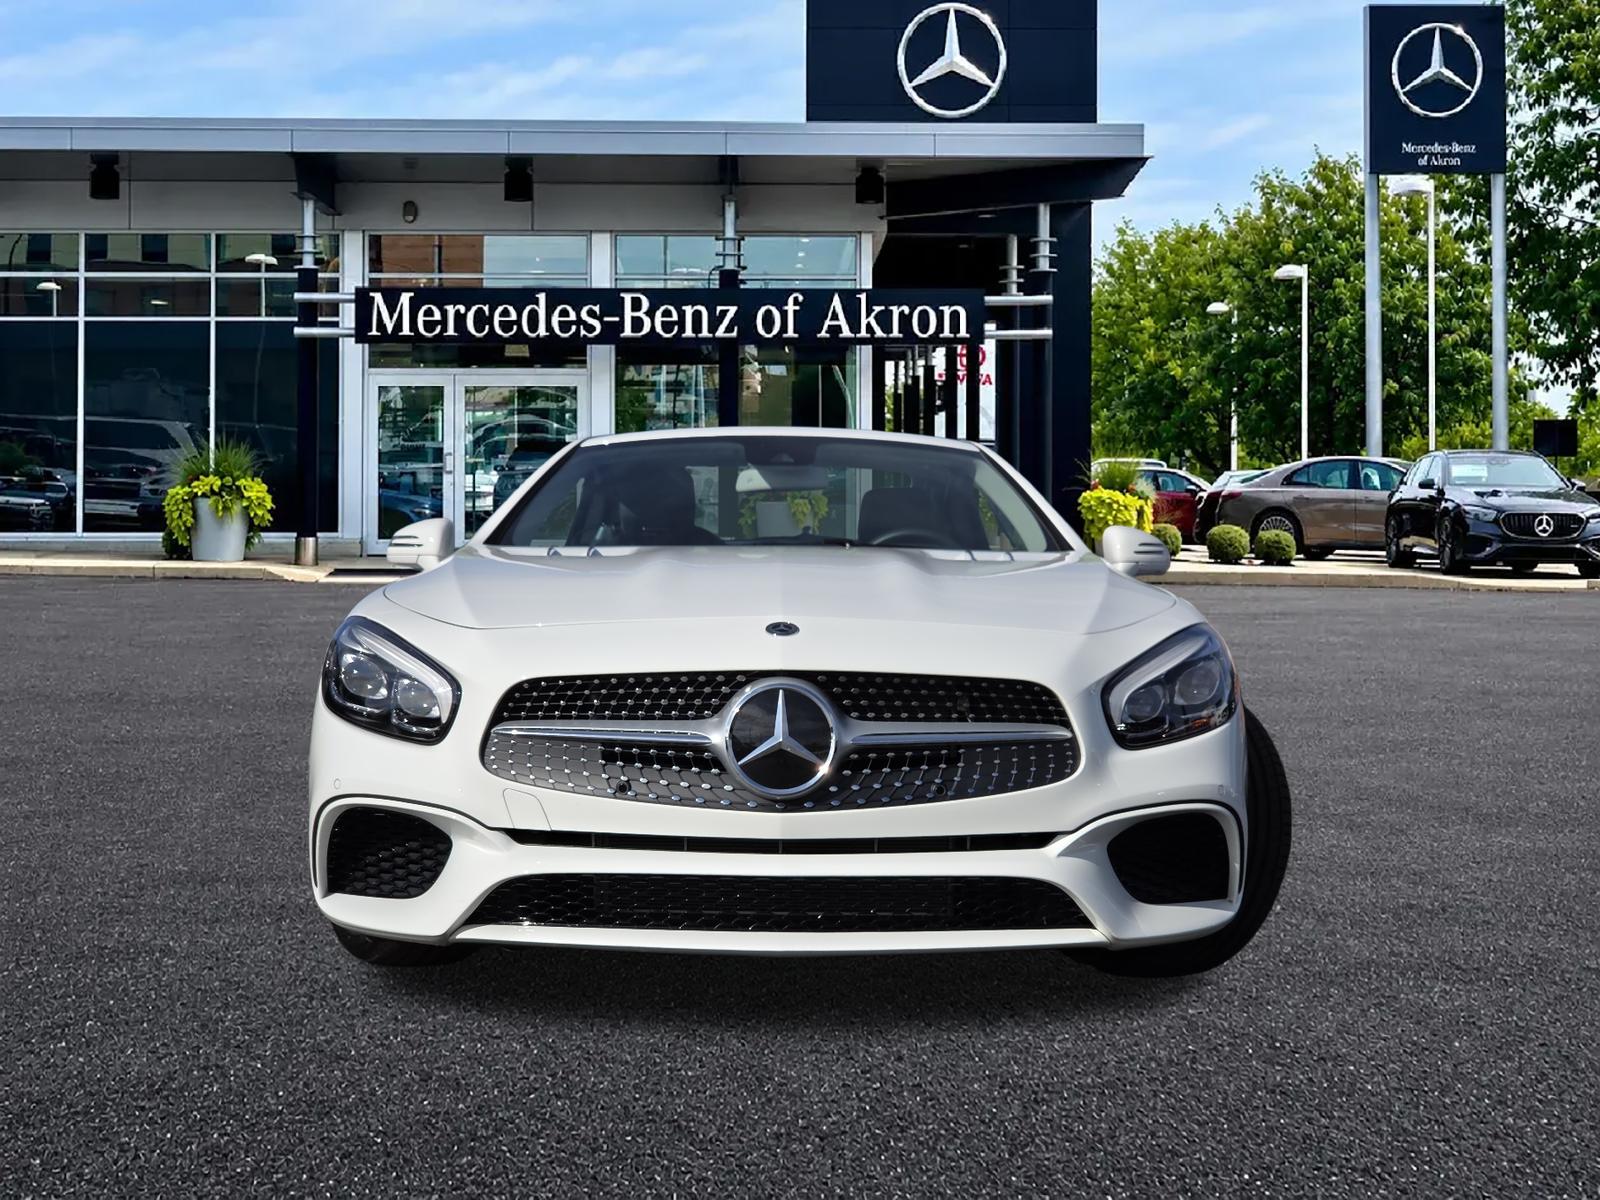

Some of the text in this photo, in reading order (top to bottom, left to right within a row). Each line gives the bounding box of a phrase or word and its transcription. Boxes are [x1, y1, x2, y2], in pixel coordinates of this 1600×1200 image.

[1401, 142, 1476, 153] Mercedes-Benz
[1418, 154, 1460, 166] of Akron
[367, 291, 970, 339] Mercedes-Benz of Akron
